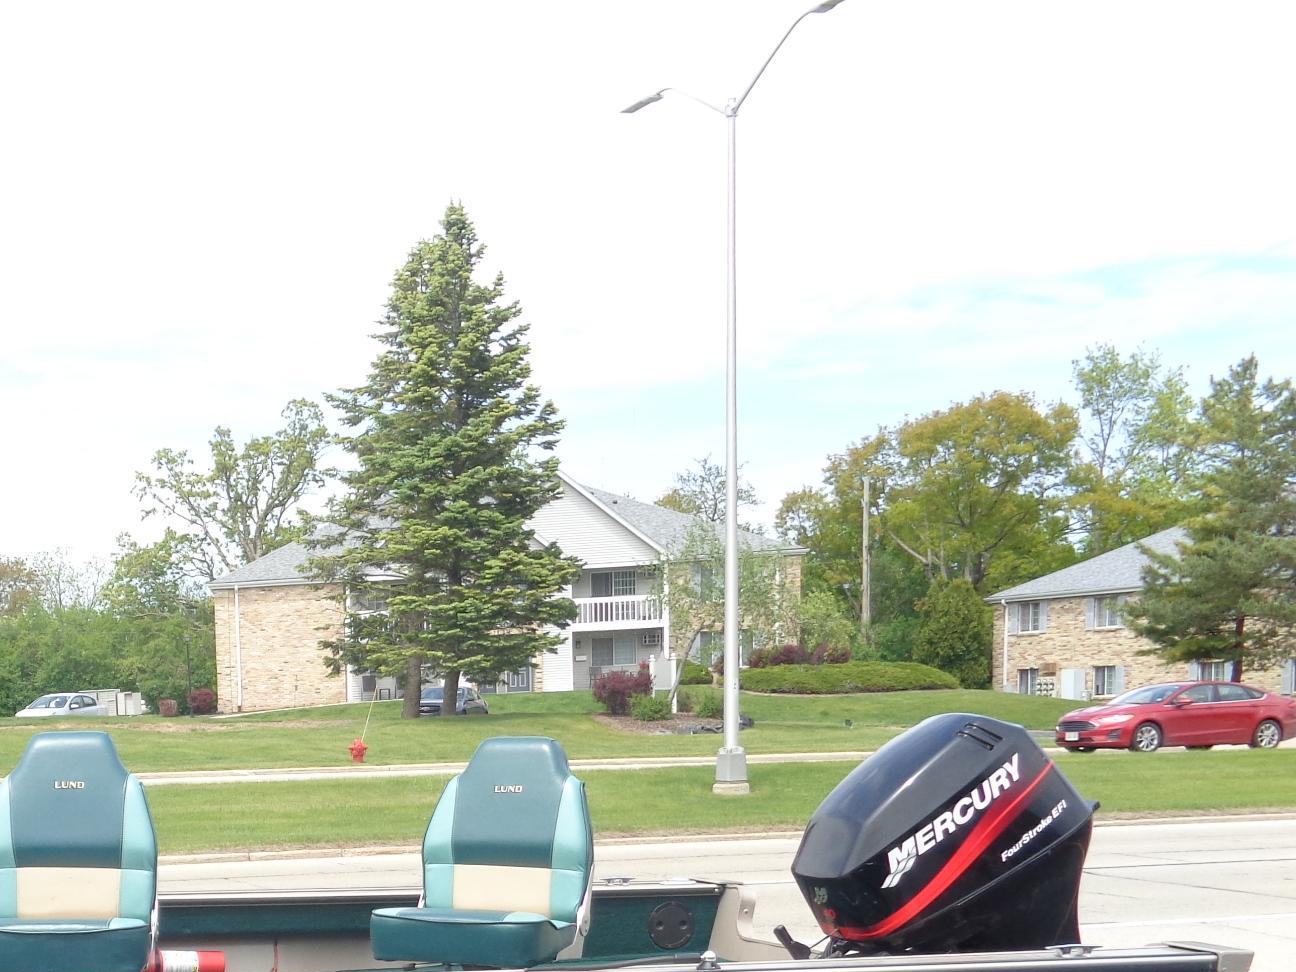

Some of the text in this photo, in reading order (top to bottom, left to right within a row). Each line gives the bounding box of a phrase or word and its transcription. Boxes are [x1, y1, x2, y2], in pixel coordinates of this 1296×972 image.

[54, 780, 85, 789] LUND
[494, 785, 523, 793] LUND
[881, 753, 1020, 888] MERCURY
[1001, 799, 1067, 862] FourStroke EFI
